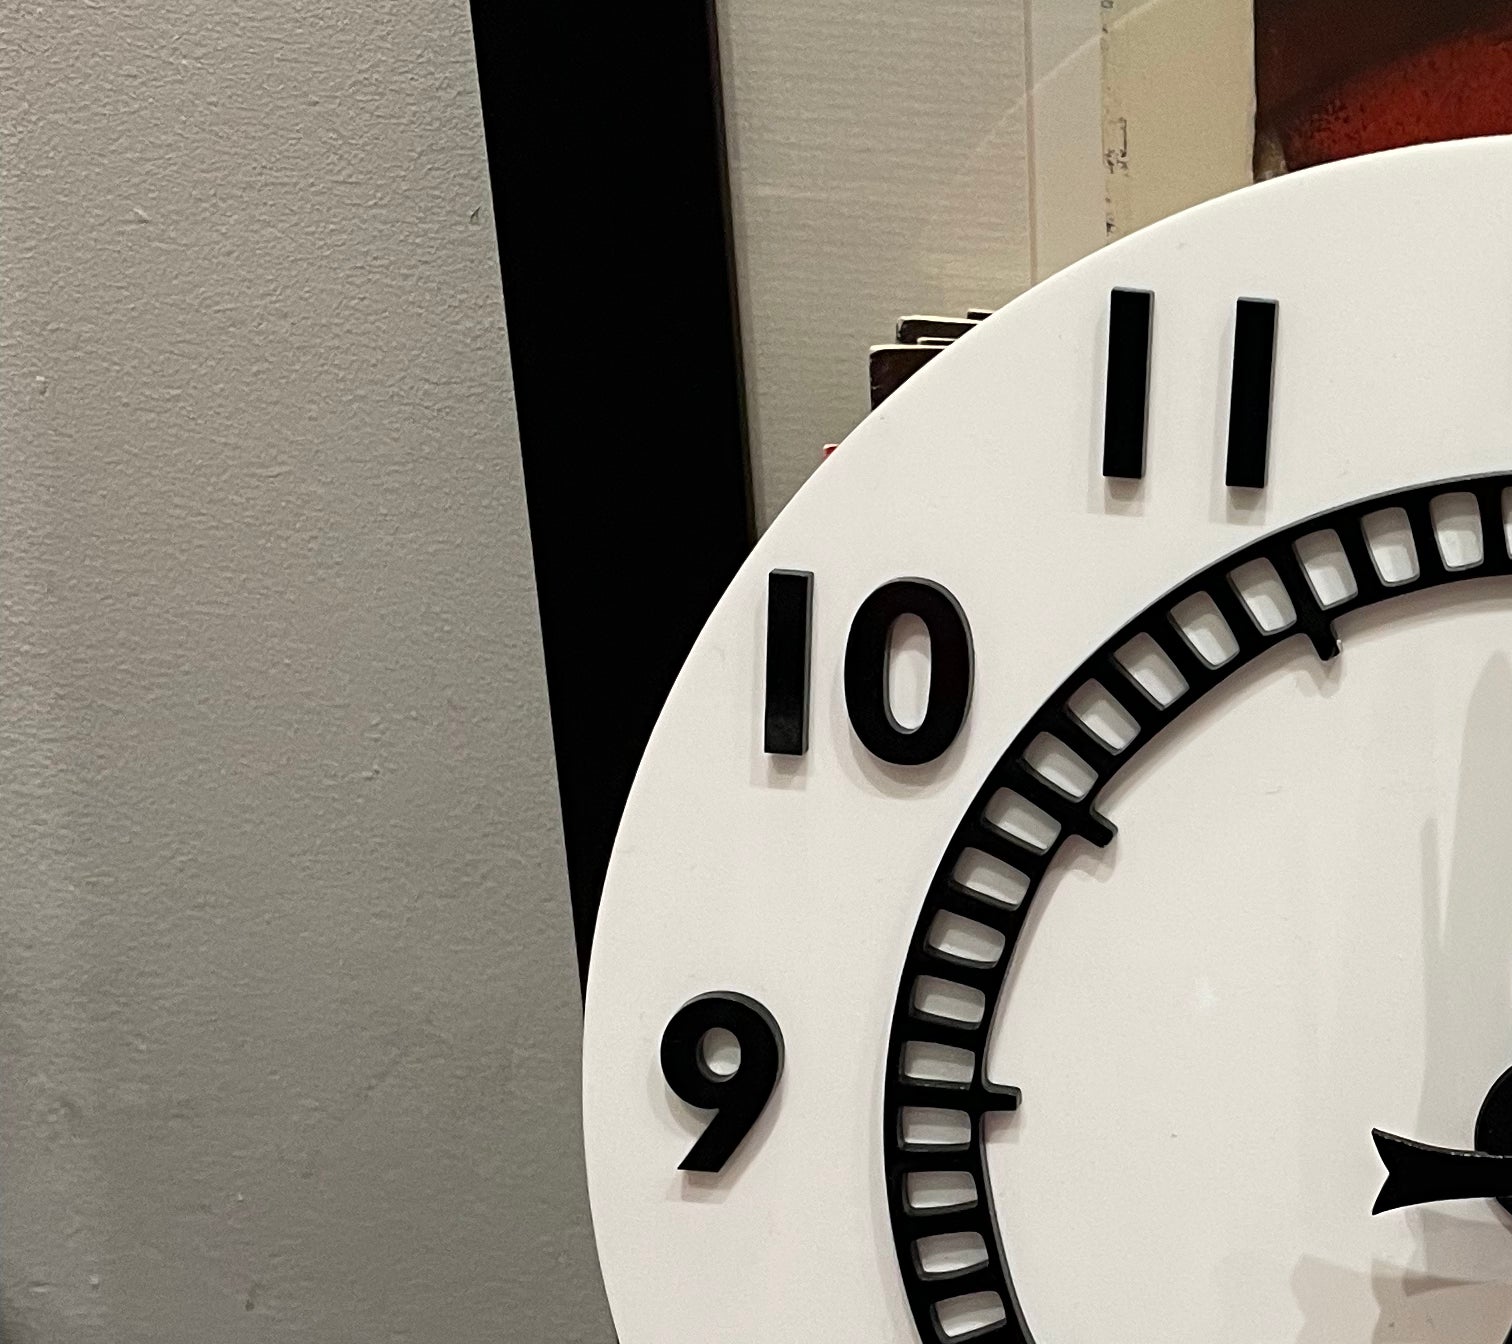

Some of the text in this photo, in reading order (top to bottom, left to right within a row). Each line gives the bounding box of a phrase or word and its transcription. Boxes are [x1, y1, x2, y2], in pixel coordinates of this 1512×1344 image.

[1102, 286, 1279, 490] 11
[764, 568, 976, 766] 10
[659, 989, 786, 1174] 9
